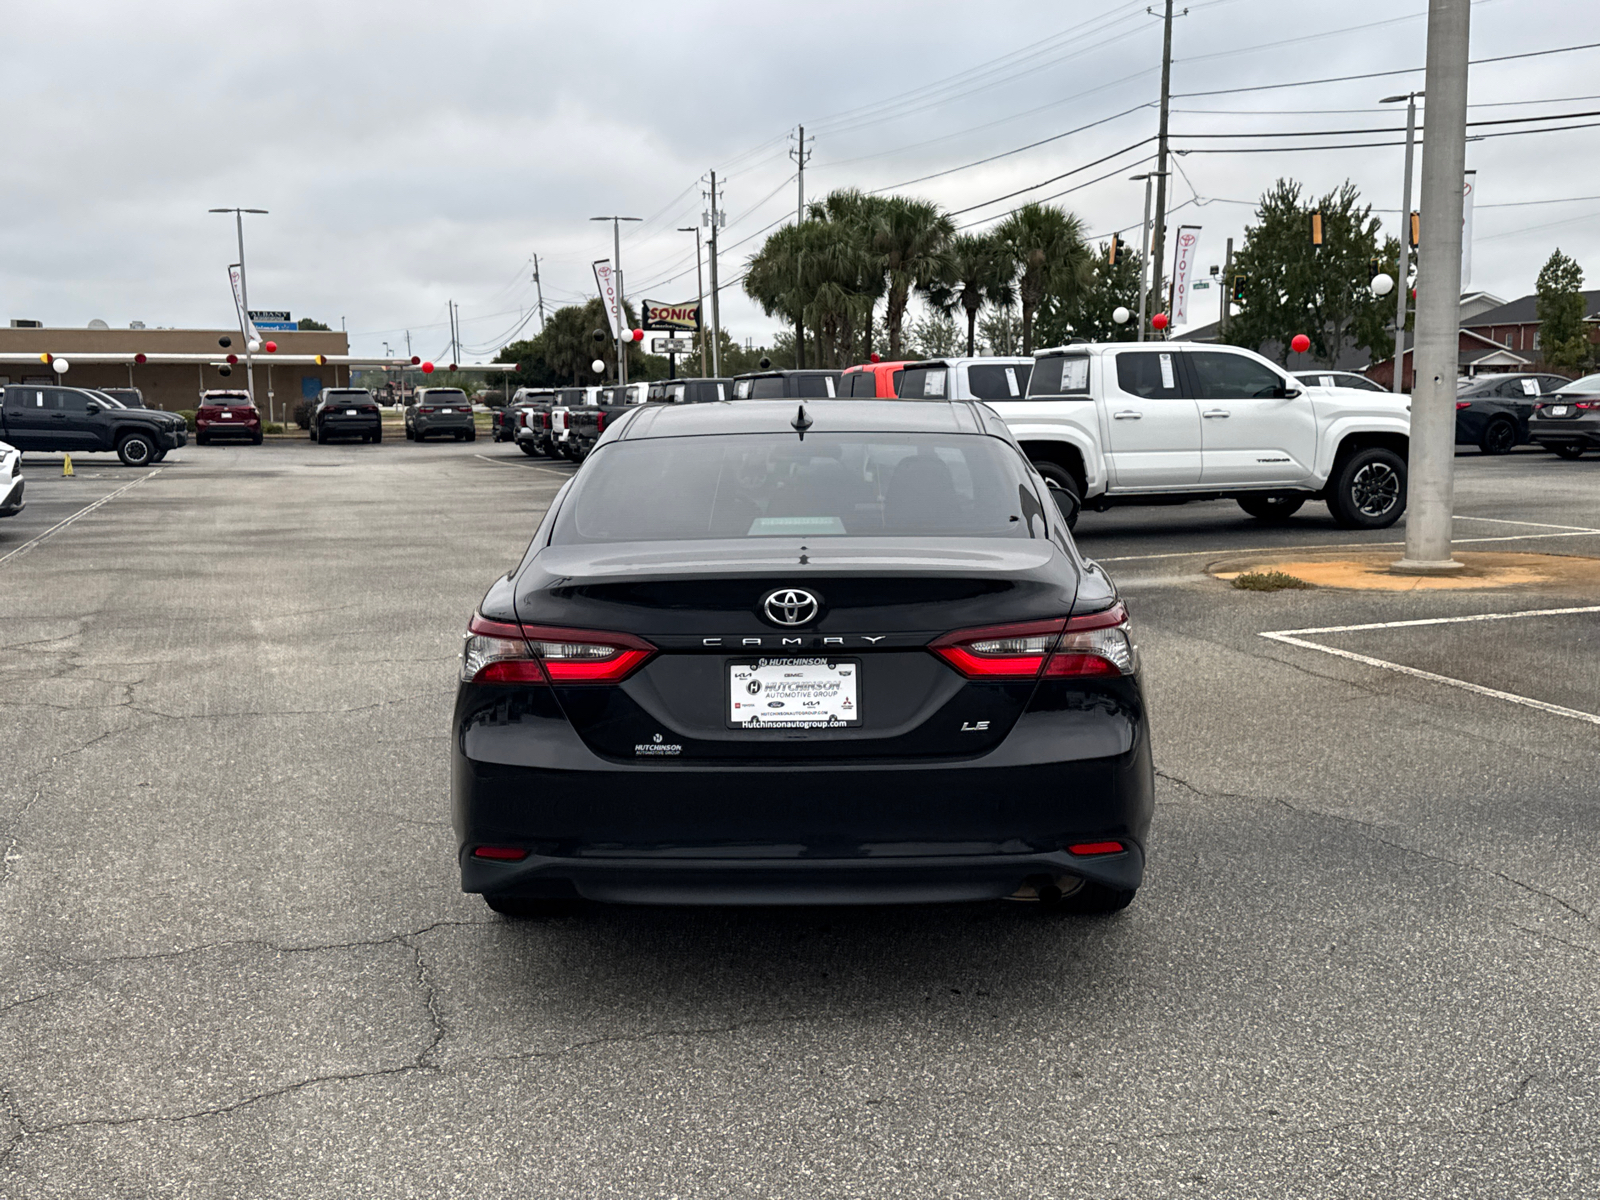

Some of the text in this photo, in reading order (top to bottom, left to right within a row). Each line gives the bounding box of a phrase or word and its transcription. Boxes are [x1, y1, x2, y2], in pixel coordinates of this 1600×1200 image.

[1177, 248, 1189, 317] TOYOTA
[649, 307, 695, 320] SONIC
[703, 635, 886, 646] CAMRY
[769, 657, 828, 667] HUTCHINSON
[764, 681, 841, 692] HUTCHINSON
[813, 690, 838, 698] GROUP
[742, 719, 847, 729] Hutchinsonautogroup.com
[960, 720, 991, 731] LE
